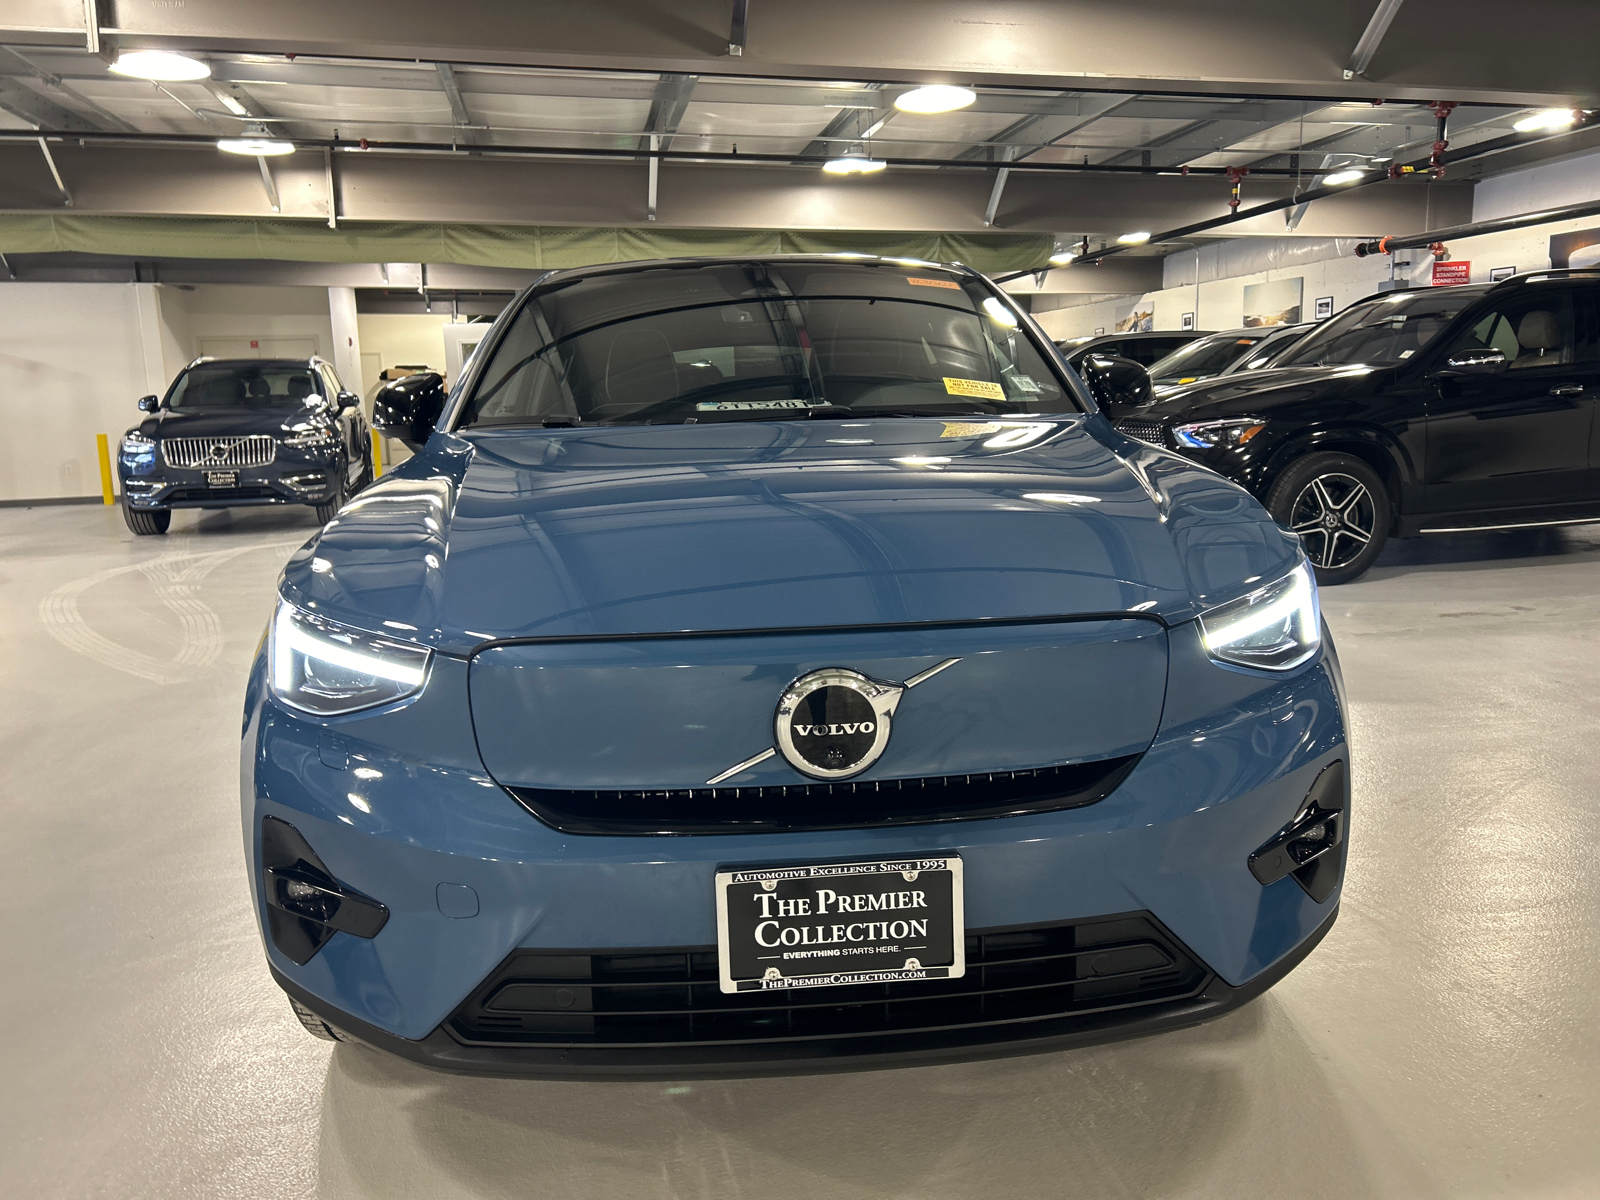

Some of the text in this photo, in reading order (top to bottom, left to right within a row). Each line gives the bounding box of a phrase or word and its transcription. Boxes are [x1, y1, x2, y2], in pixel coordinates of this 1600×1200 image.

[793, 721, 875, 737] VOLVO
[735, 860, 945, 883] AUTOMOTIVE EXCELLENCE SINCE 1995
[753, 889, 928, 919] THE PREMIER
[754, 919, 928, 948] COLLECTION
[783, 945, 901, 960] EVERYTHING STARTS HERE.
